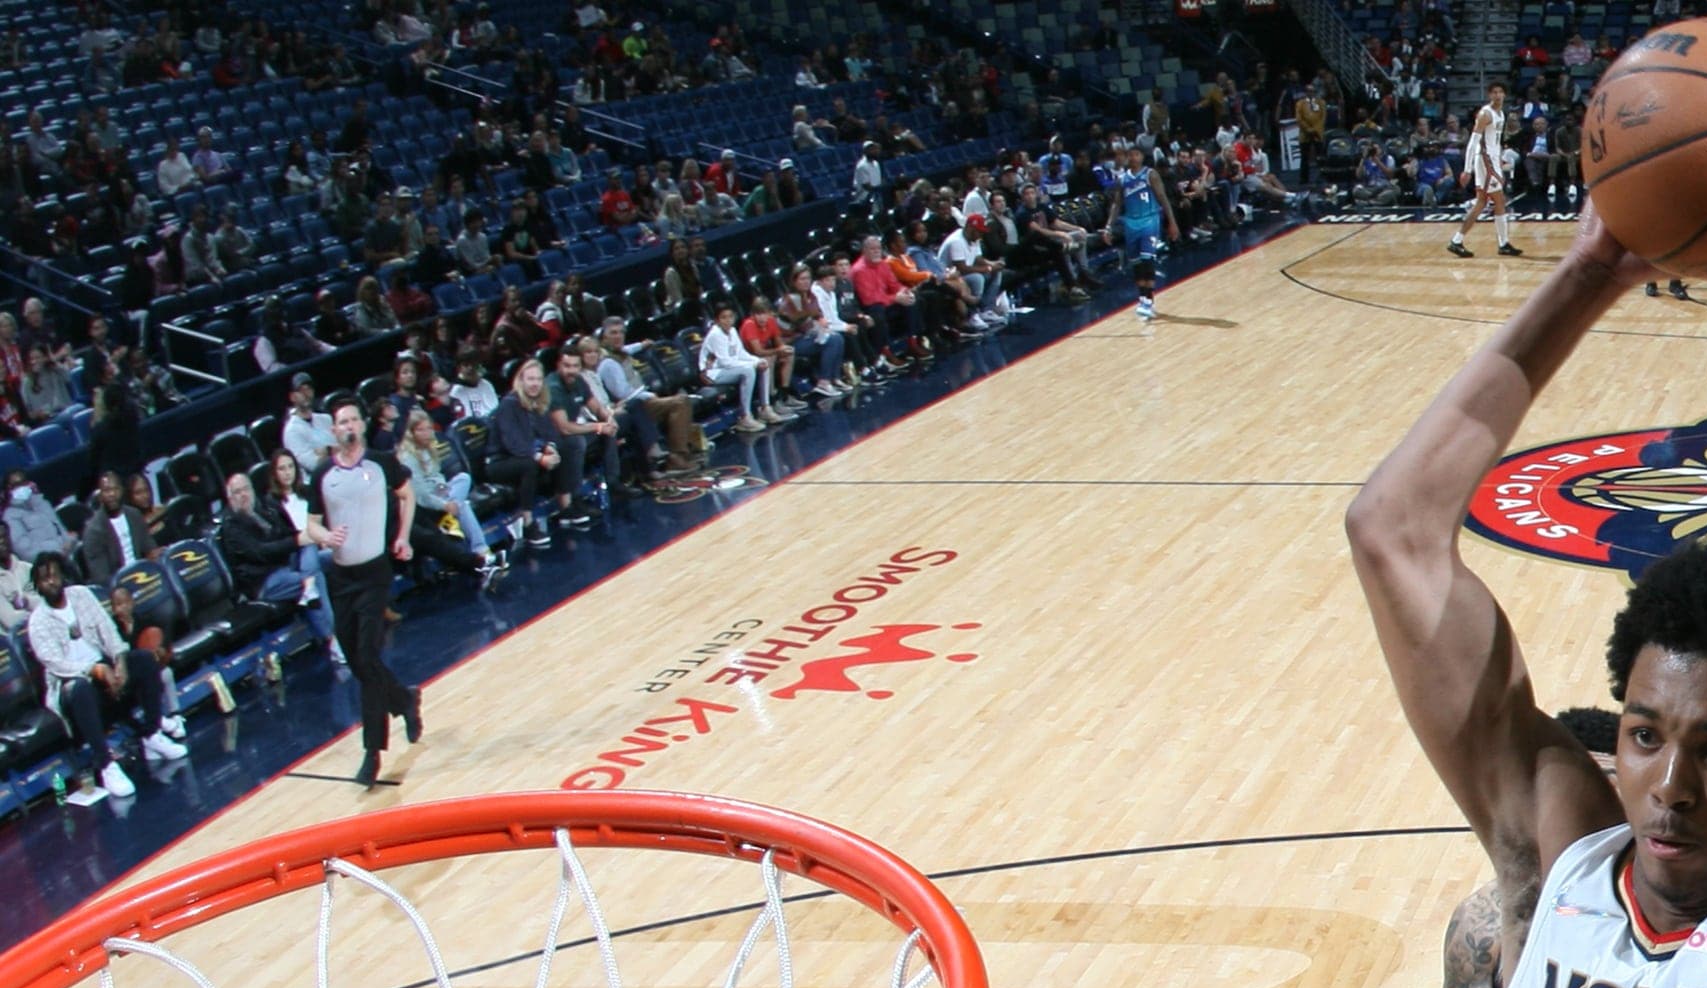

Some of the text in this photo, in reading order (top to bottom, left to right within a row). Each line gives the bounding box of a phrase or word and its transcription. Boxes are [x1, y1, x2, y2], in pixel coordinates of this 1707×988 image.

[1140, 191, 1149, 203] 4
[1318, 212, 1582, 223] NEW ORLEAN
[1495, 444, 1626, 538] PELICANS
[704, 546, 959, 686] SMOOTHIE
[634, 618, 764, 694] CENTER
